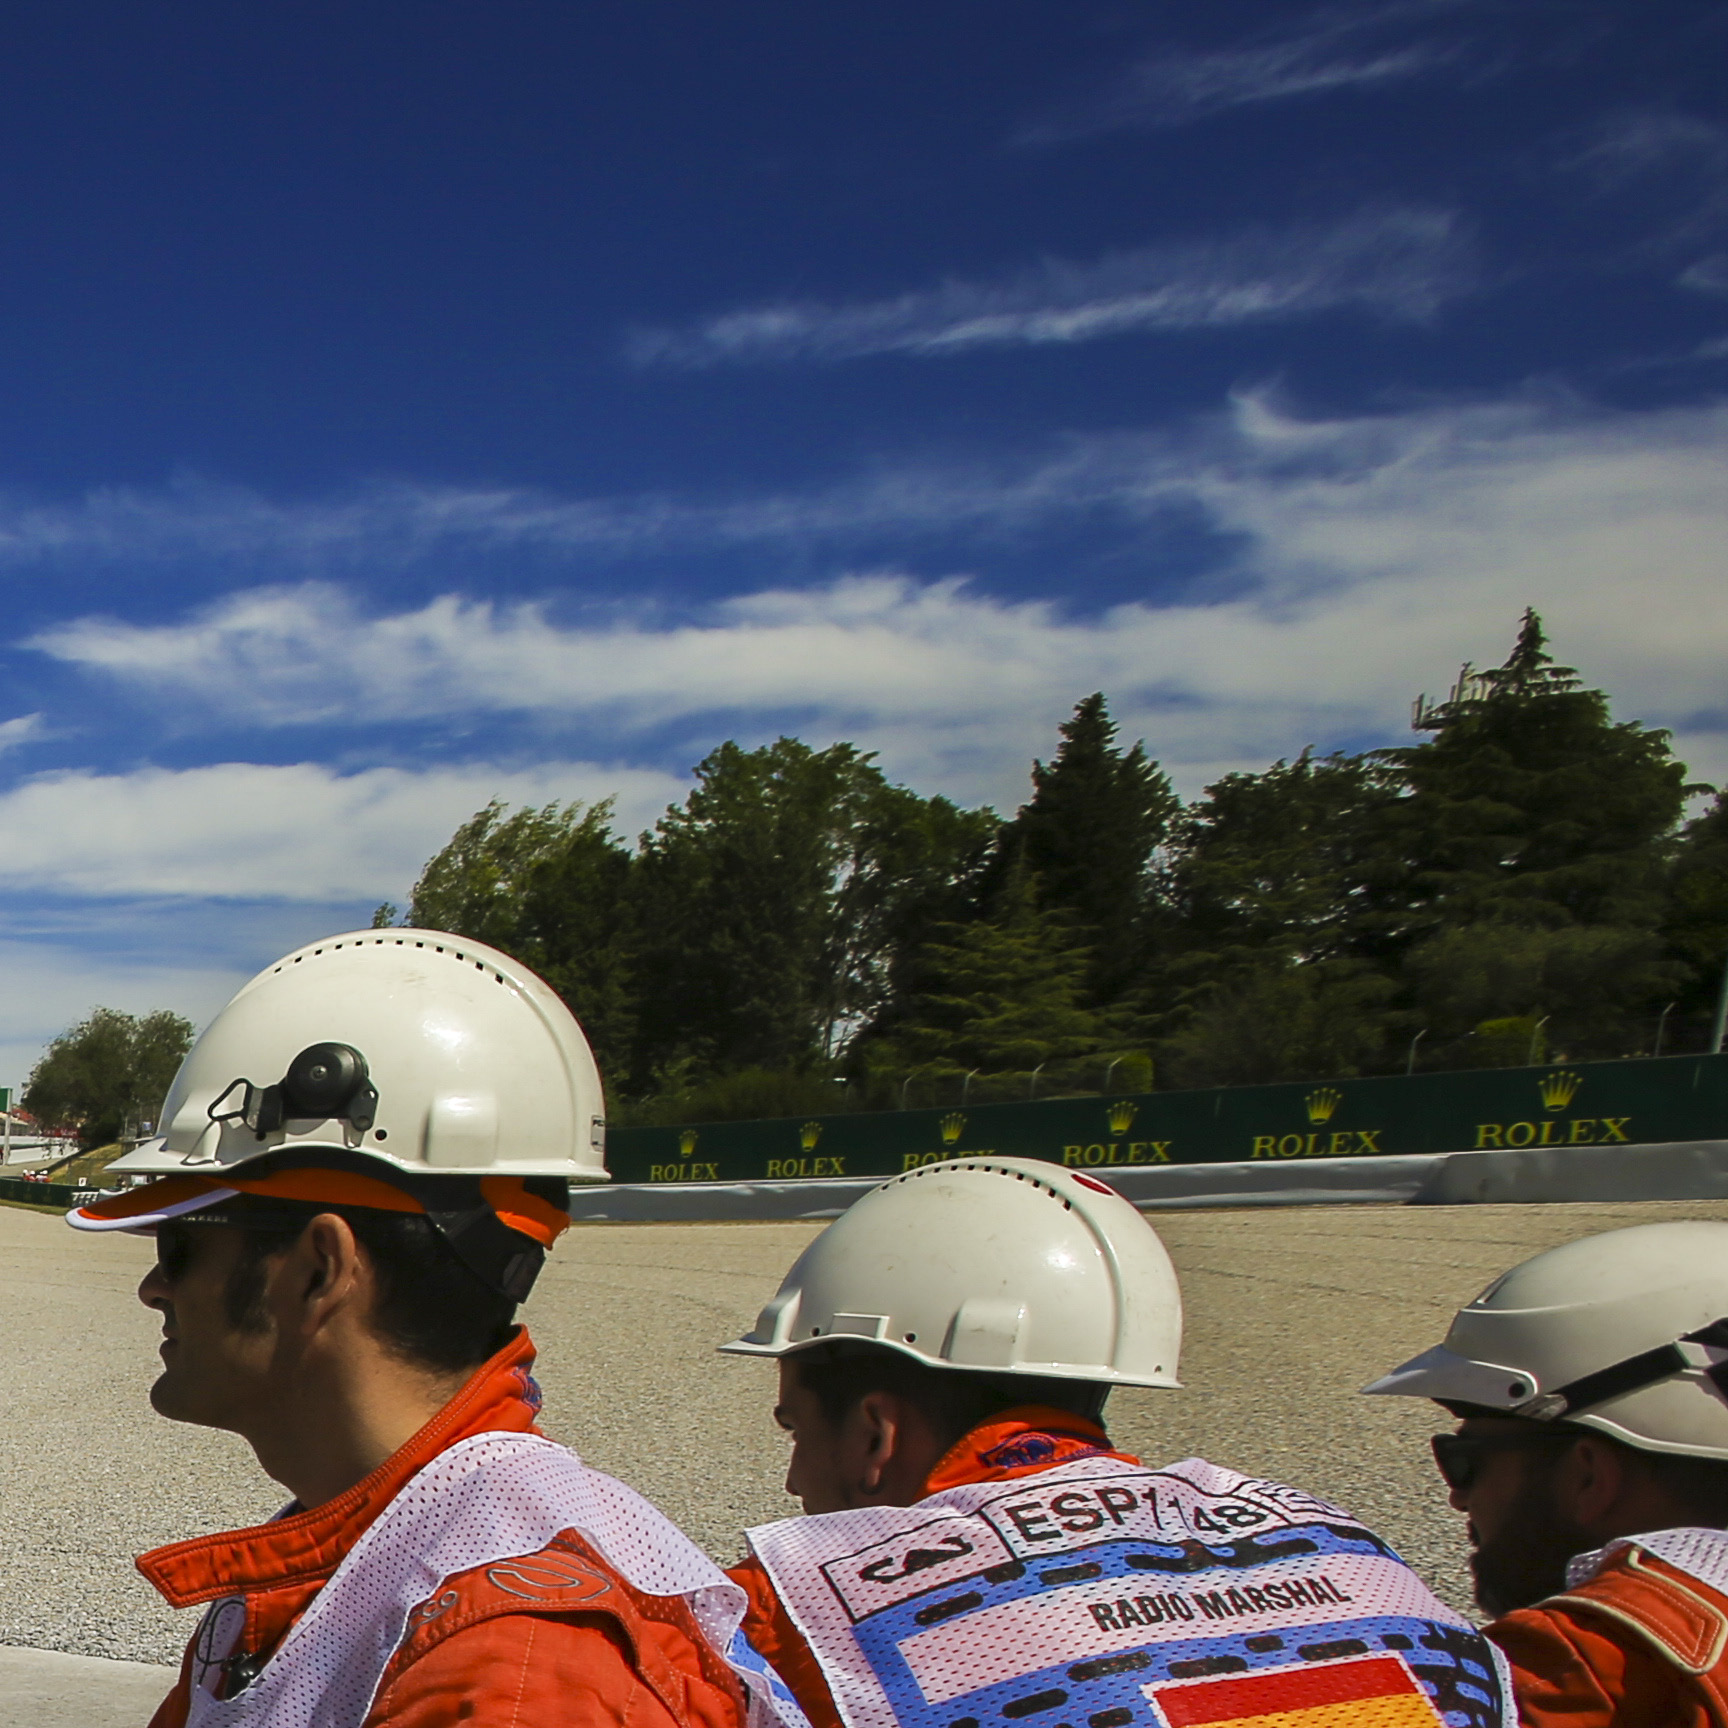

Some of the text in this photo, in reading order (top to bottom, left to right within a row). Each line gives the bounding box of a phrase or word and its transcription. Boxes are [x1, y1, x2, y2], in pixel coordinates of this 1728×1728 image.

[1252, 1131, 1380, 1157] ROLEX
[1475, 1118, 1630, 1147] ROLEX
[767, 1157, 844, 1177] ROLEX
[1060, 1141, 1171, 1169] ROLEX
[650, 1163, 718, 1181] ROLEX
[1089, 1575, 1351, 1632] RADIO MARSHAL
